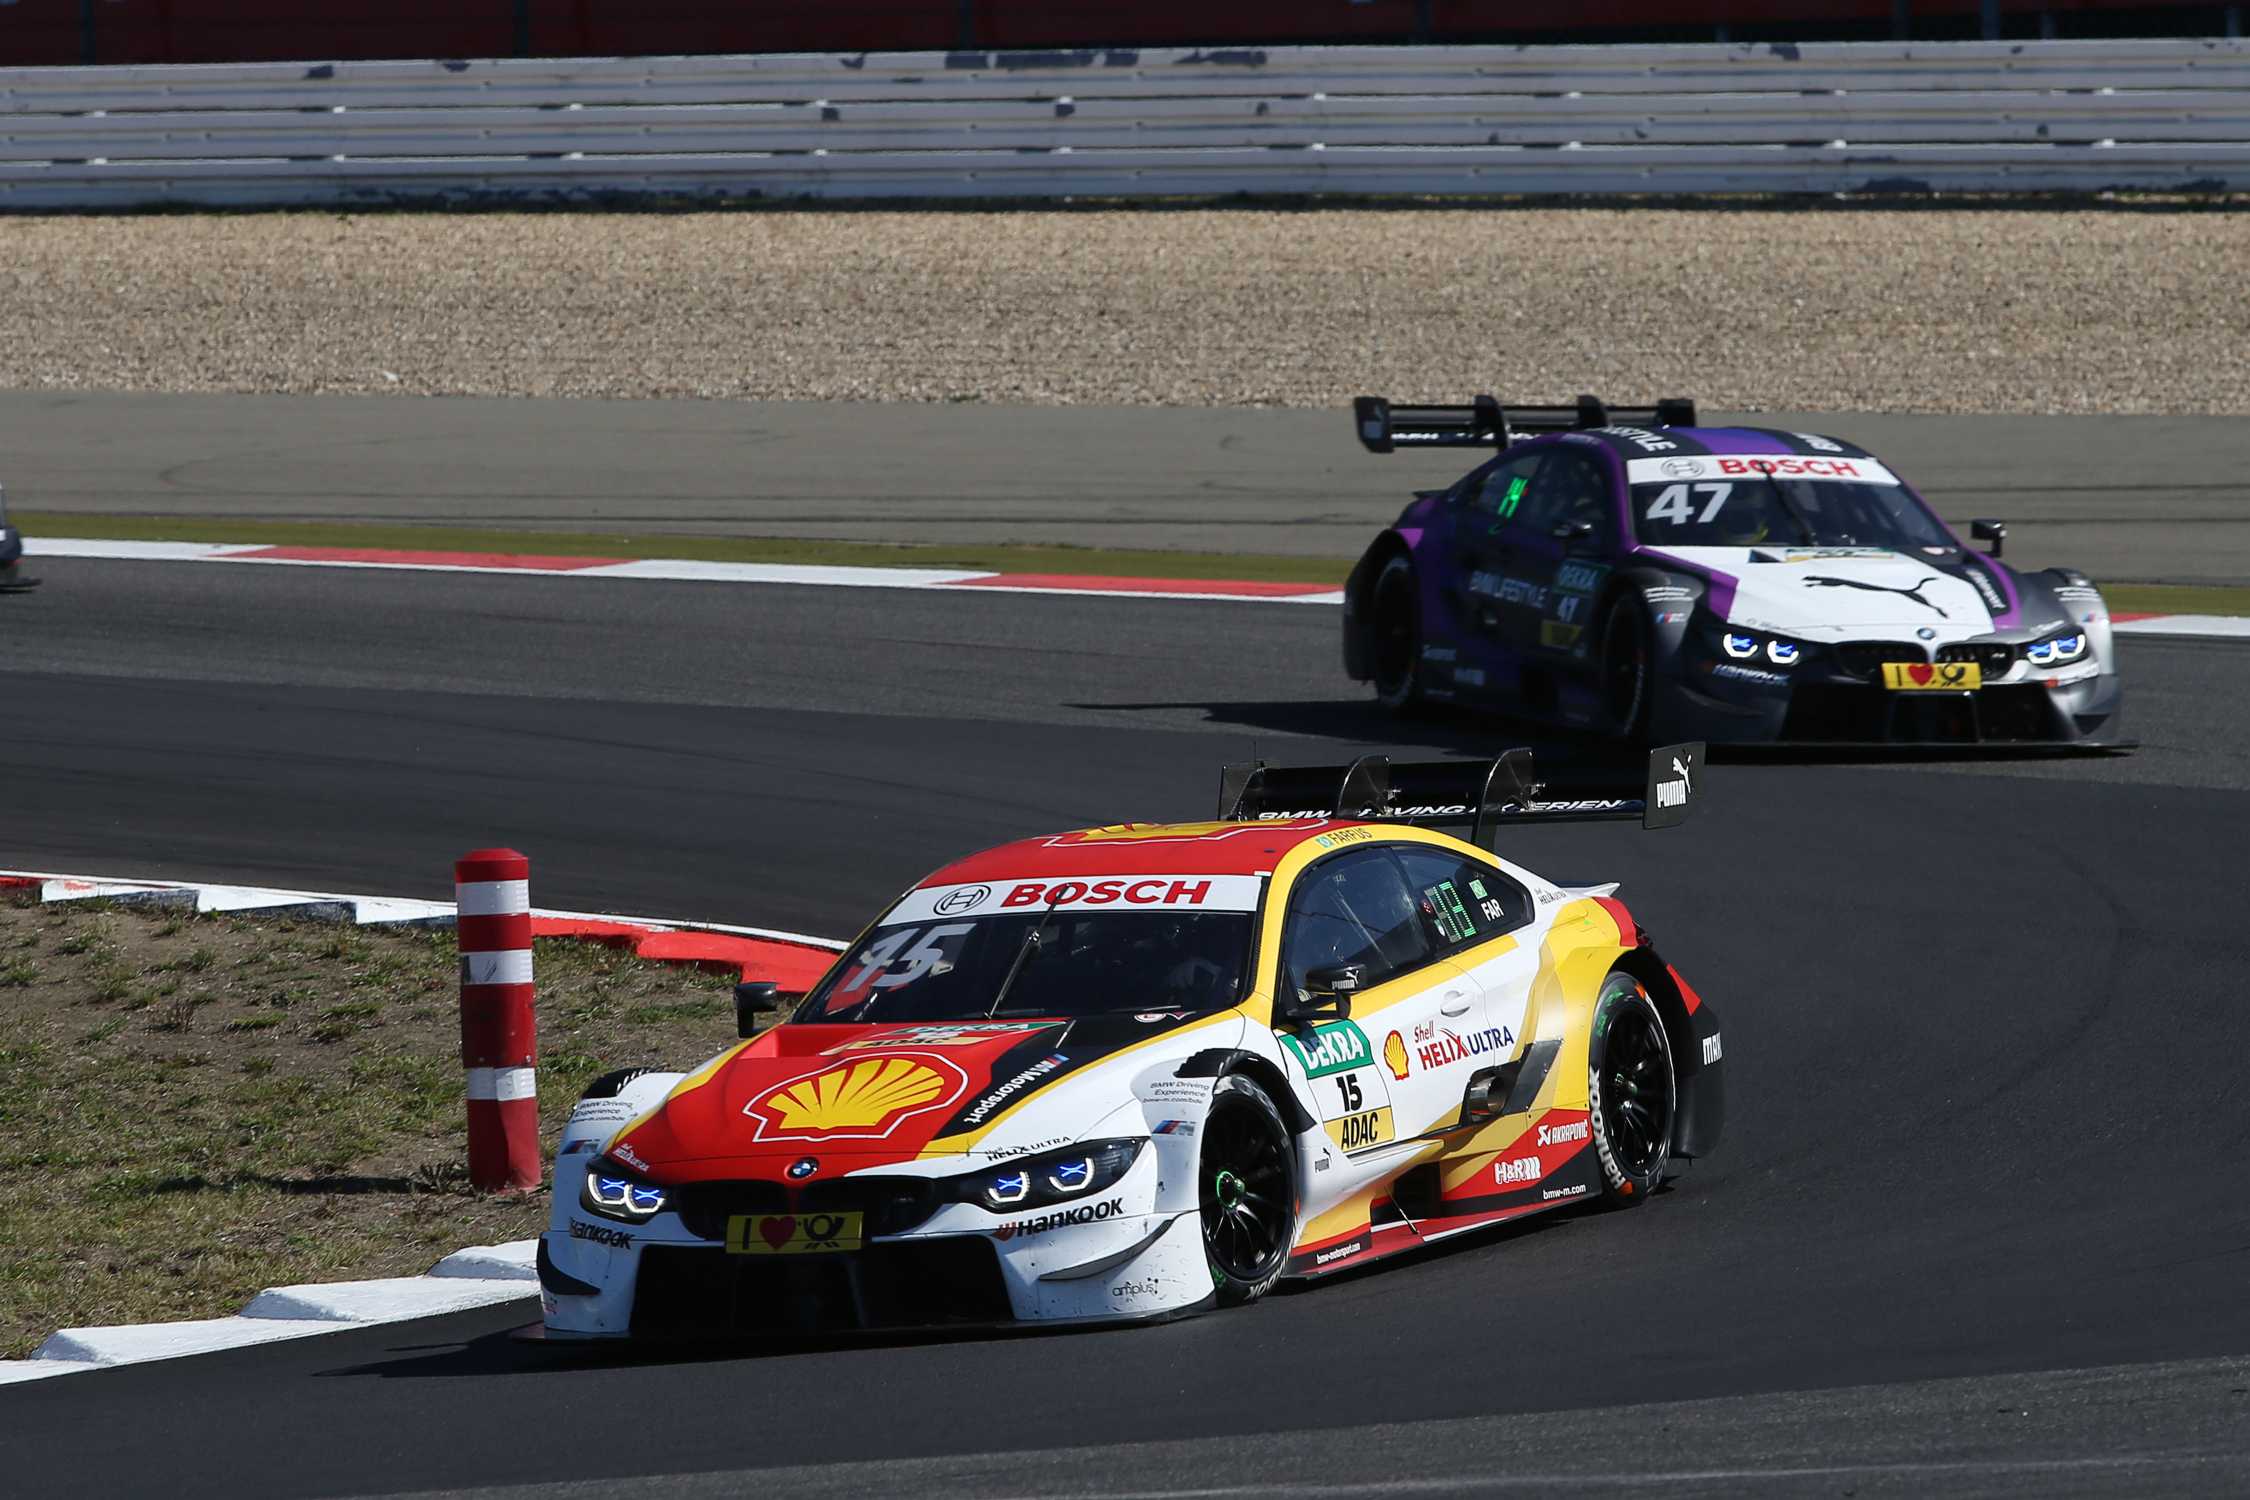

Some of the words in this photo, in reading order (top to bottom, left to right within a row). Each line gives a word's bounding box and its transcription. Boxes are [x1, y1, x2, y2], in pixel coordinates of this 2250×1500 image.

[1718, 459, 1861, 478] BOSCH
[1645, 482, 1733, 525] 47
[1656, 779, 1687, 809] PUMA
[1329, 827, 1373, 848] FARFUS
[1001, 880, 1211, 908] BOSCH
[1481, 898, 1505, 922] FAR
[1331, 978, 1356, 991] PUMA
[1414, 1020, 1434, 1044] Shell
[1296, 1027, 1365, 1071] DEKRA
[1417, 1033, 1470, 1070] HELIX
[1467, 1025, 1515, 1056] ULTRA
[963, 1067, 1042, 1124] Motorsport
[1154, 1089, 1207, 1098] Experience
[1176, 1081, 1210, 1090] Driving
[1335, 1073, 1363, 1112] 15
[1030, 1136, 1073, 1150] ULTRA
[1341, 1112, 1378, 1150] ADAC
[1543, 1184, 1587, 1200] bmw-m.com
